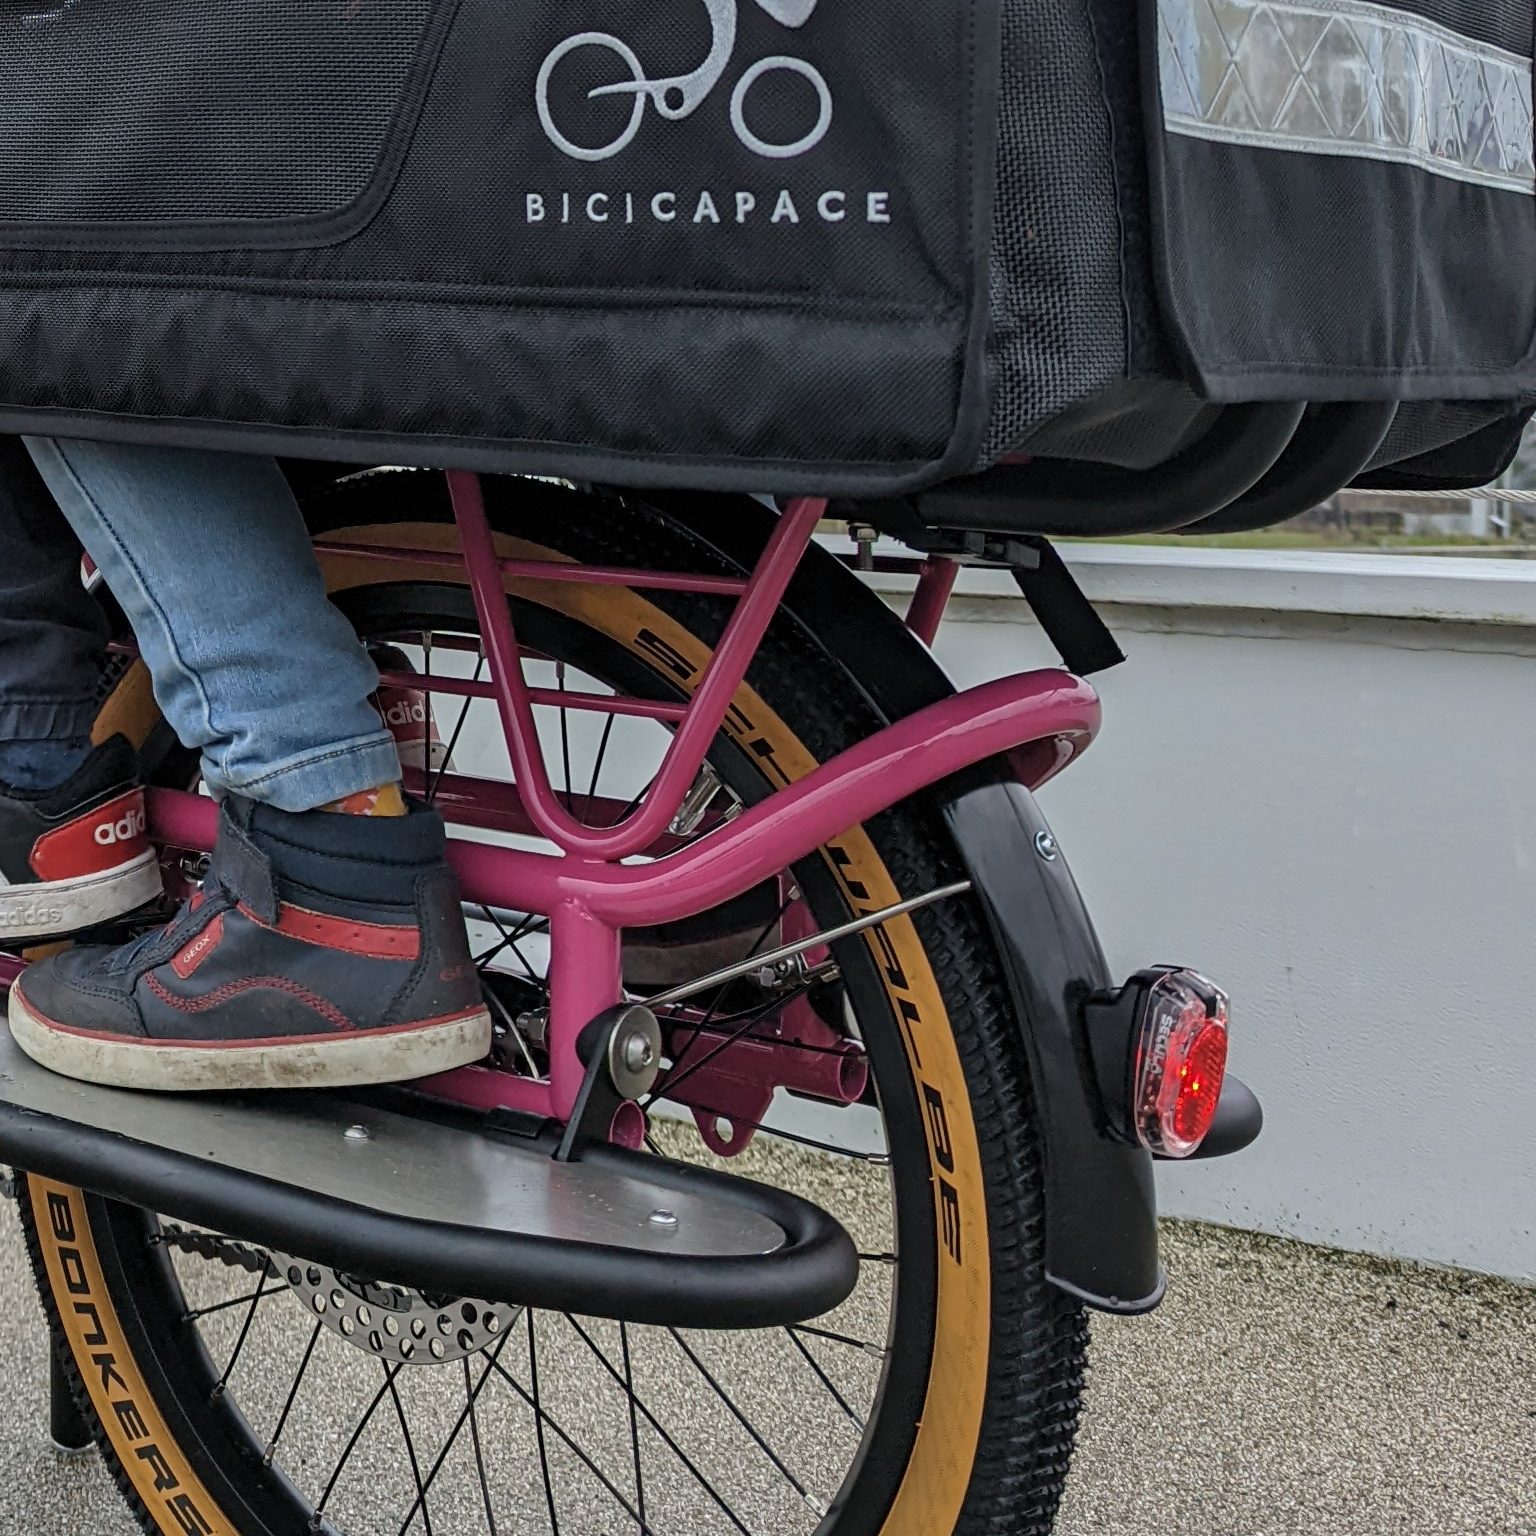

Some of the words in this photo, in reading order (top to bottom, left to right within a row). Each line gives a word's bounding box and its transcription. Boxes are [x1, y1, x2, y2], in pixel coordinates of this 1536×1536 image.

[525, 189, 891, 224] BICICAPACE
[183, 935, 211, 963] GEOX
[47, 1190, 215, 1536] BONKERS
